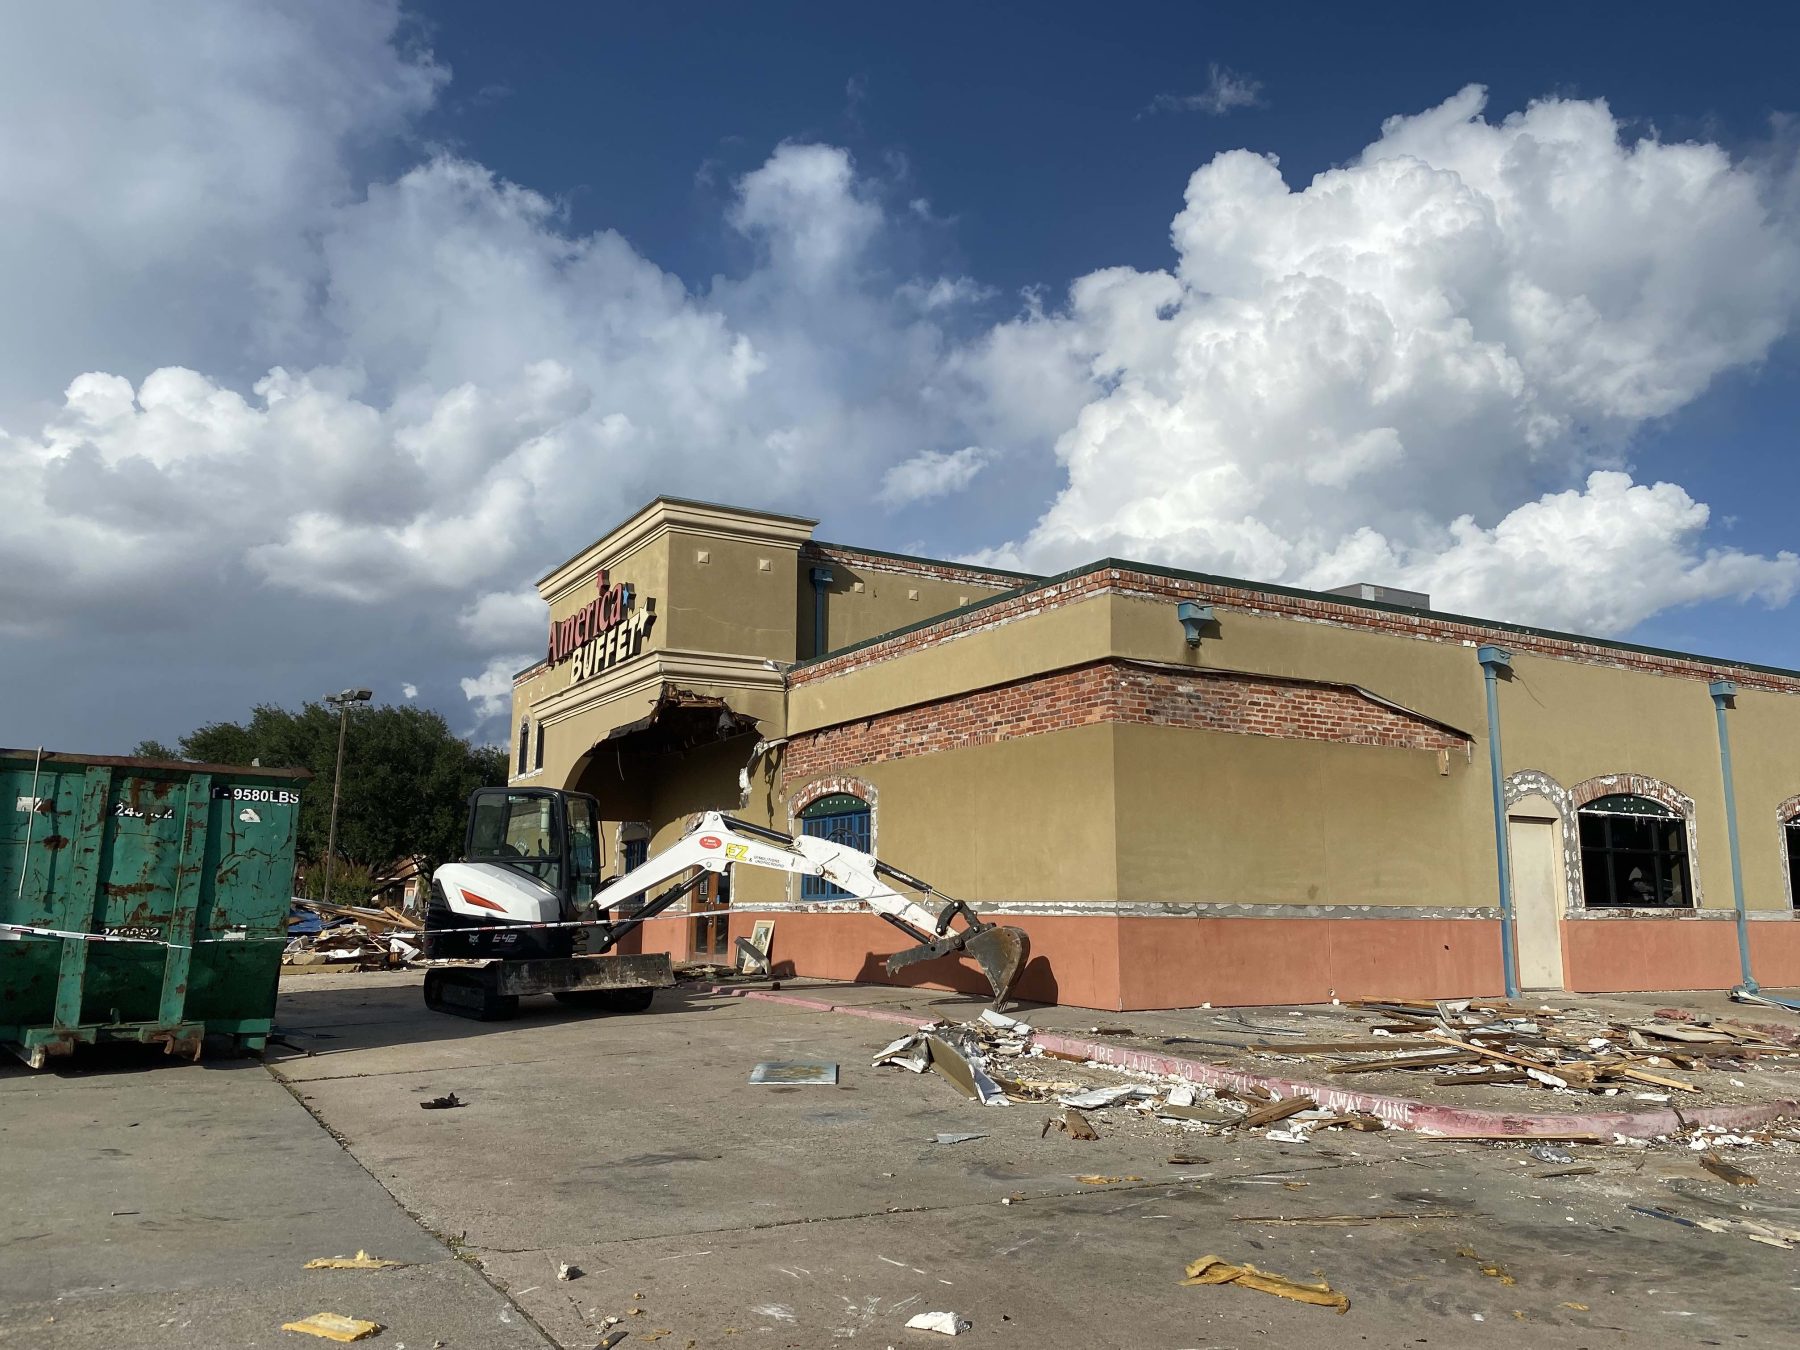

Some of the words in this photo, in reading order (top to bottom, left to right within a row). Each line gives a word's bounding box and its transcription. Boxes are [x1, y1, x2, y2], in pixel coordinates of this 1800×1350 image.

[548, 570, 624, 664] America
[571, 612, 640, 684] BUFFET
[233, 788, 299, 804] 9580LBS
[726, 843, 749, 862] EZ
[1086, 1044, 1114, 1064] FIRE
[1123, 1051, 1157, 1074] LANE
[1174, 1062, 1193, 1080] NO
[1328, 1090, 1363, 1114] AWAY
[1371, 1098, 1414, 1124] ZONE
